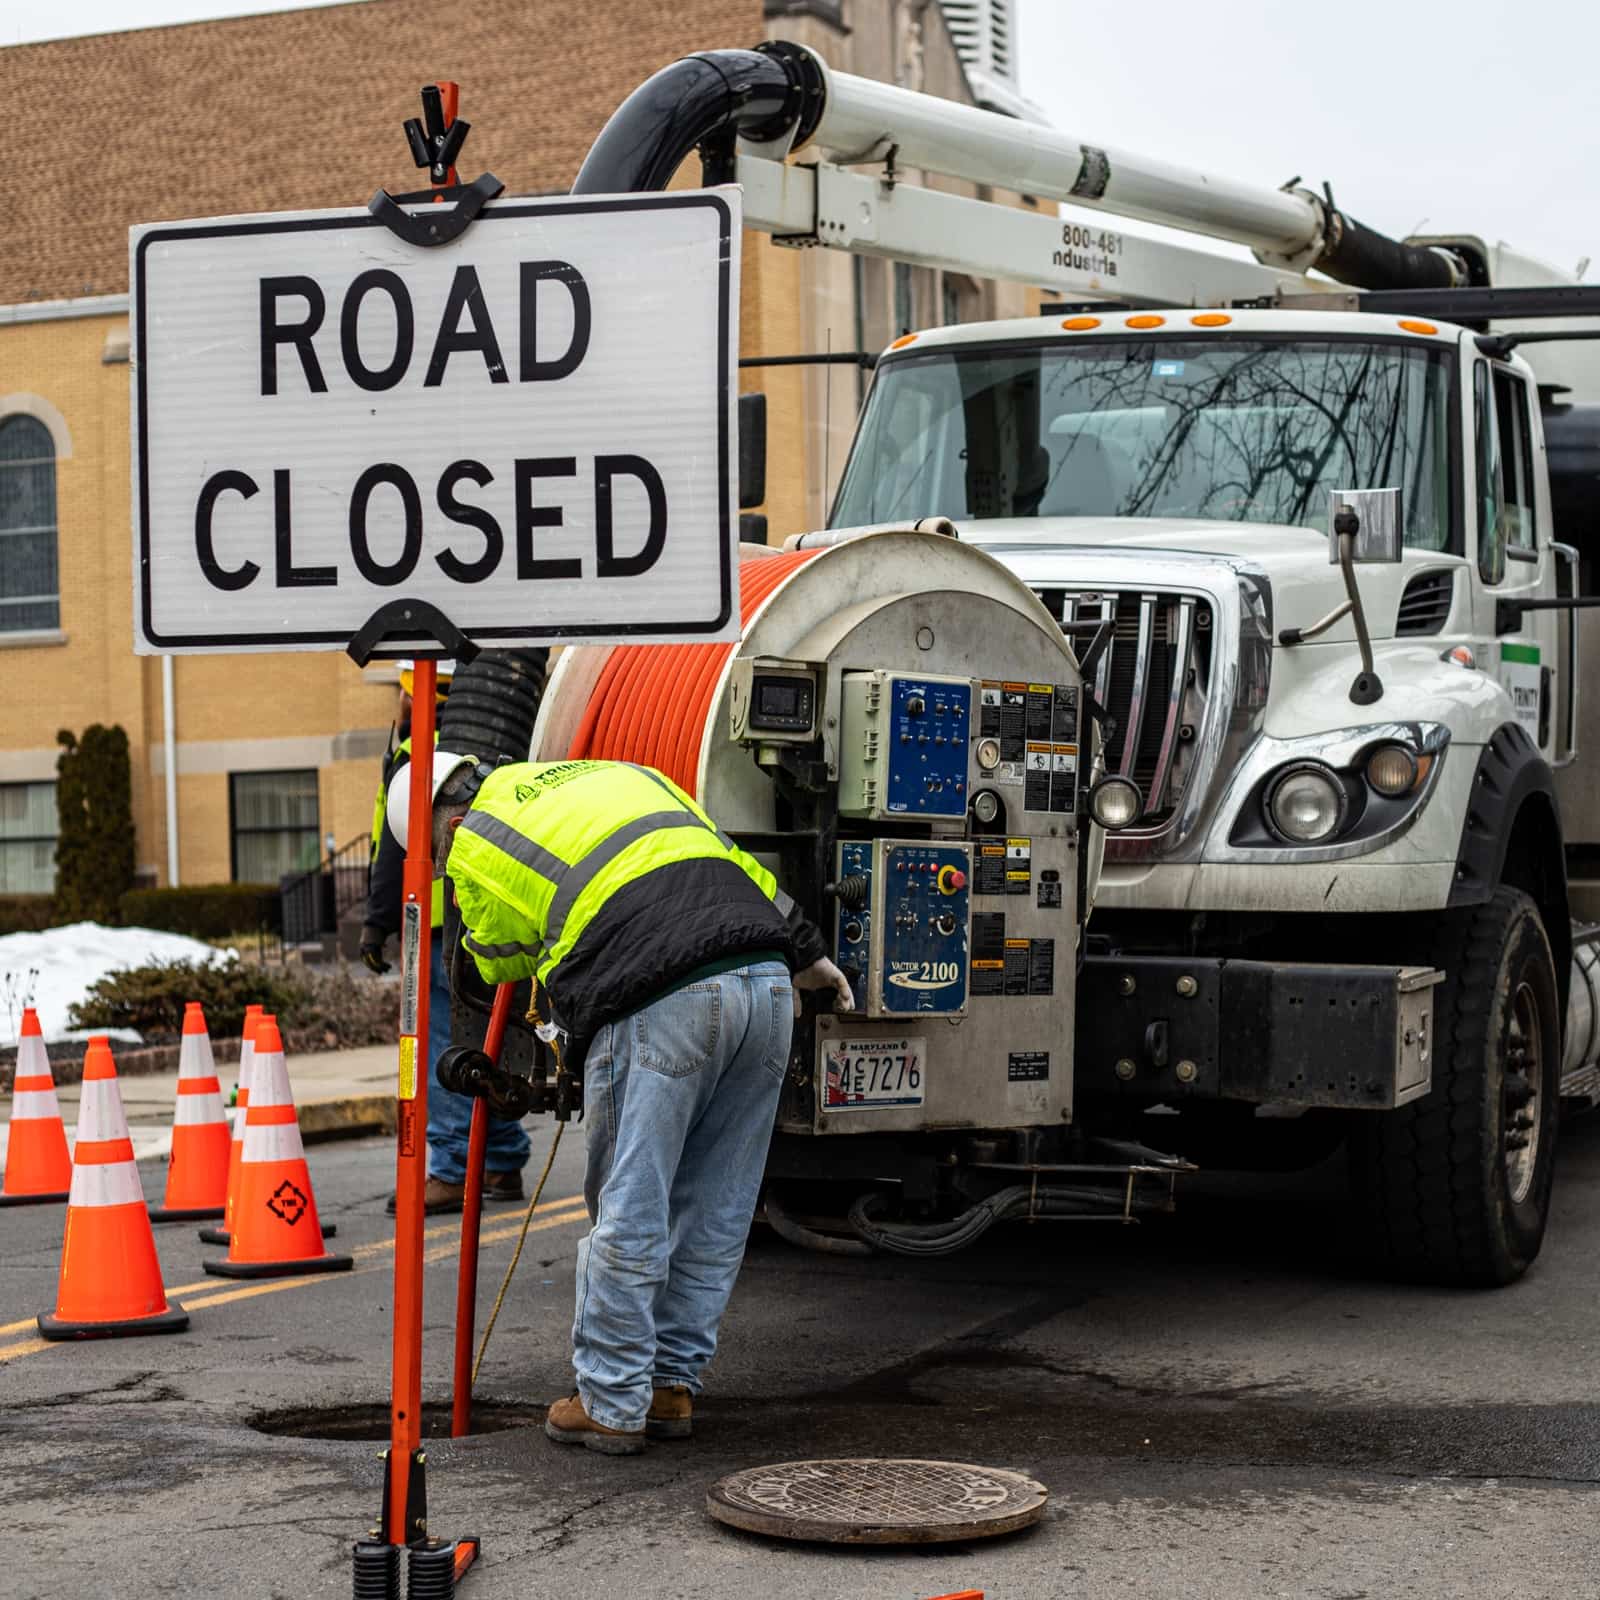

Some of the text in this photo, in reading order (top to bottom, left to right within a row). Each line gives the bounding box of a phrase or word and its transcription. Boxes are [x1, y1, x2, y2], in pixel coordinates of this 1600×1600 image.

[260, 260, 592, 396] ROAD
[195, 454, 667, 591] CLOSED
[891, 961, 919, 971] VACTOR
[920, 961, 959, 981] 2100
[850, 1043, 899, 1052] MARYLAND
